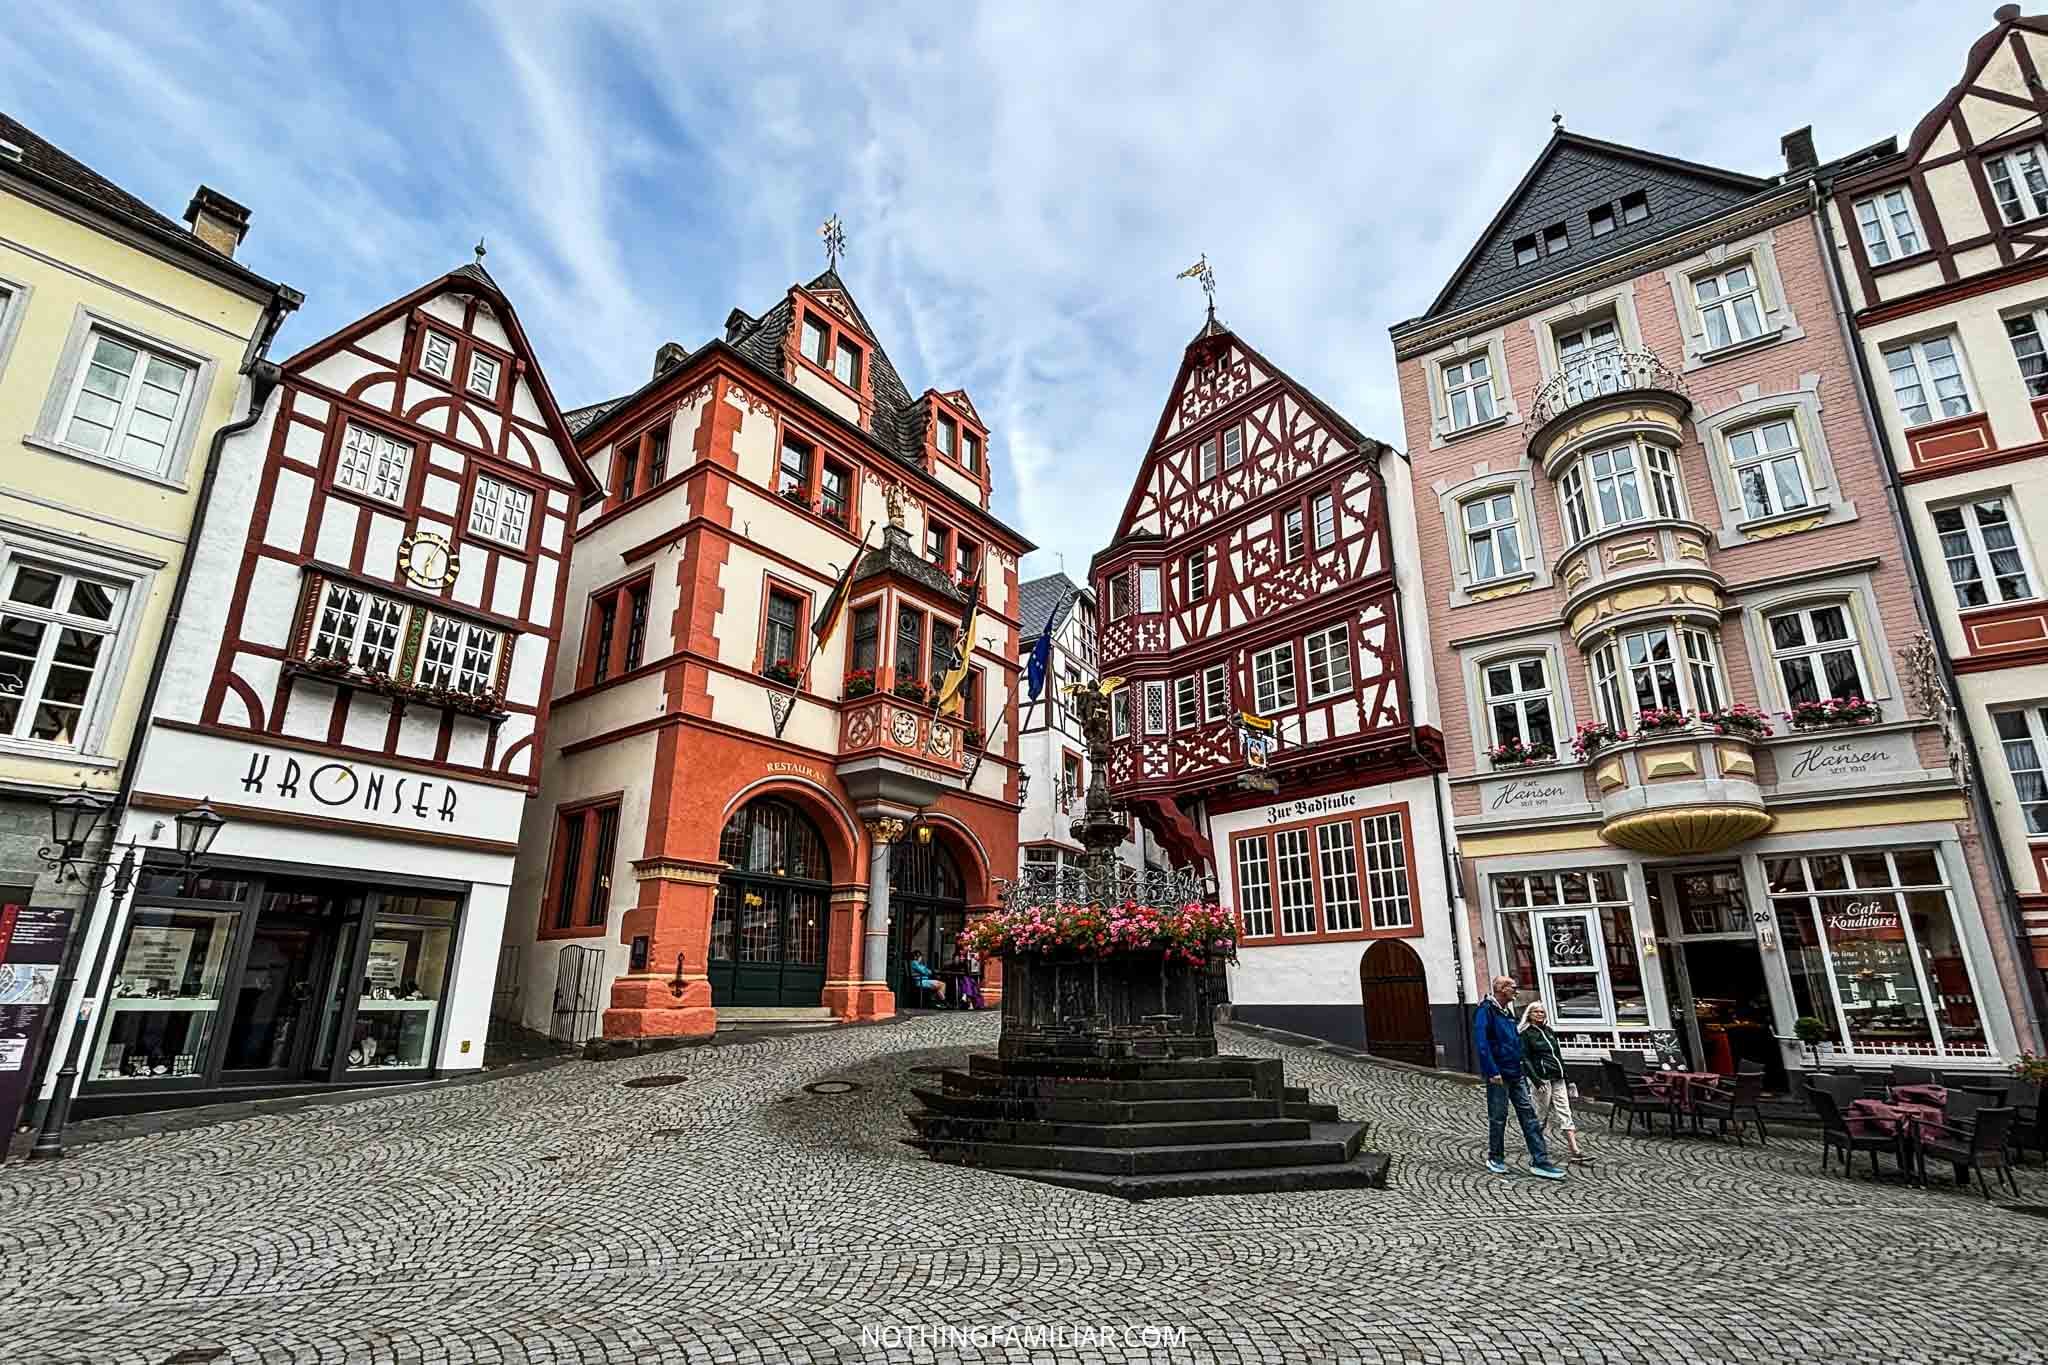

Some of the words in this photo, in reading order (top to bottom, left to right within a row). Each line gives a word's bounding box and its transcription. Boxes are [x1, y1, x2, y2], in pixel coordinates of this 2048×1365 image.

[1791, 744, 1889, 778] Hansen
[240, 752, 457, 822] KRONSER
[1492, 783, 1565, 810] Hansen
[1267, 806, 1292, 824] Zur
[1753, 911, 1770, 922] 26
[1827, 913, 1898, 931] Konditorei
[1551, 932, 1584, 957] Eis
